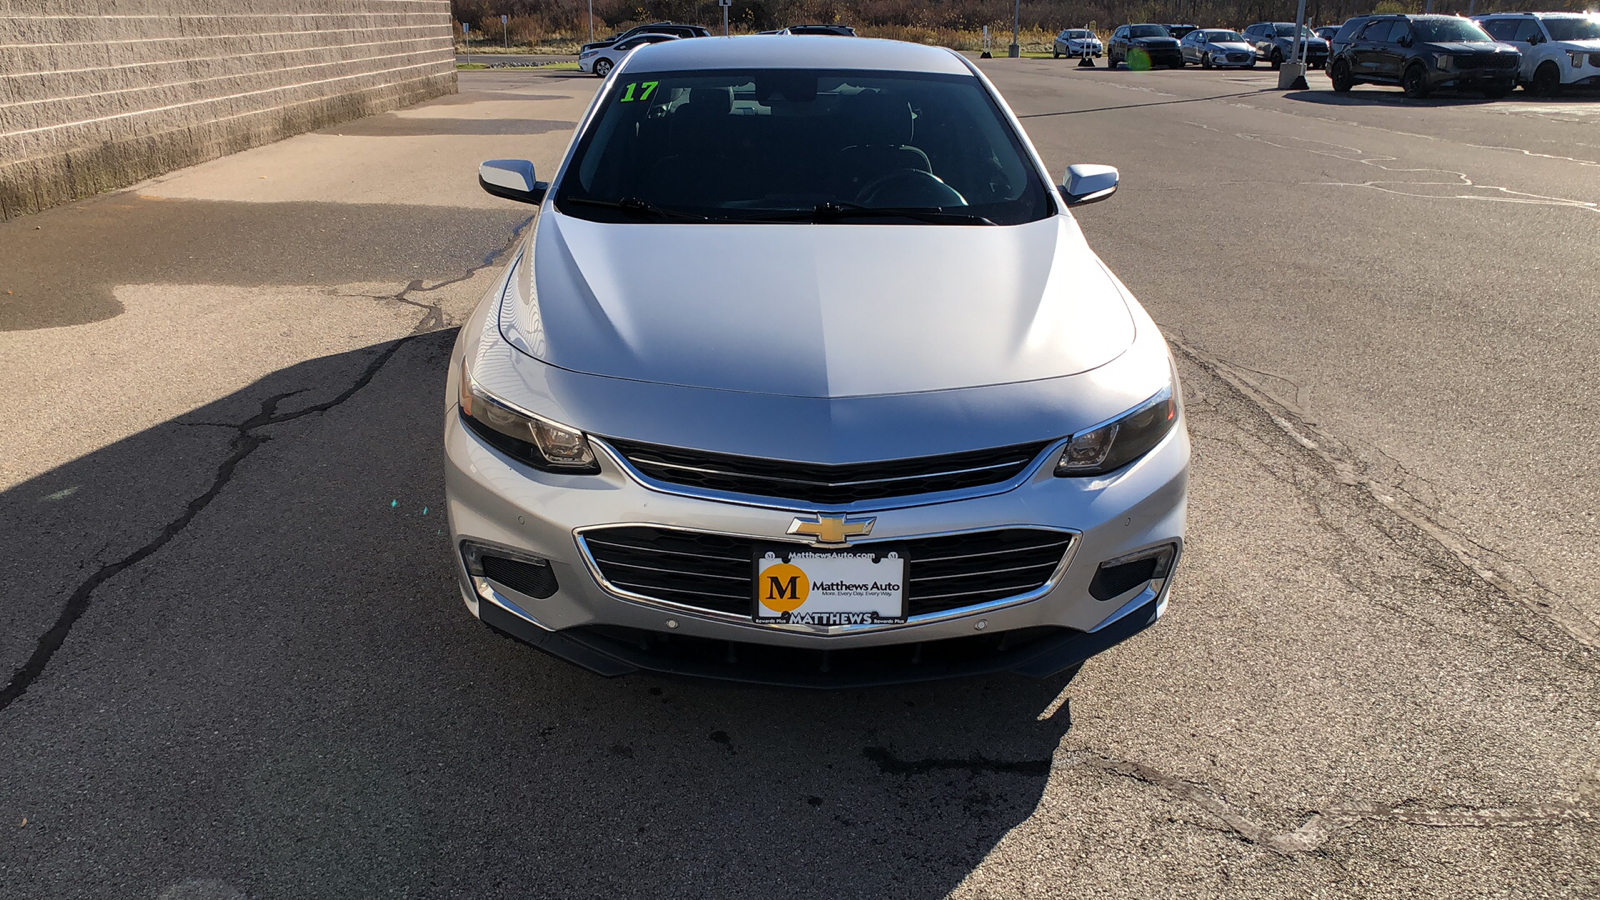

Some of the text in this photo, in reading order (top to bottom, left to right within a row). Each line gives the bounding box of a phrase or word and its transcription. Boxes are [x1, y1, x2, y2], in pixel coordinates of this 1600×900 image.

[620, 81, 659, 102] 17
[788, 551, 876, 559] MatthewsAuto.com
[766, 576, 801, 600] M
[812, 581, 901, 591] Matthews Auto
[789, 613, 872, 624] MATTHEWS
